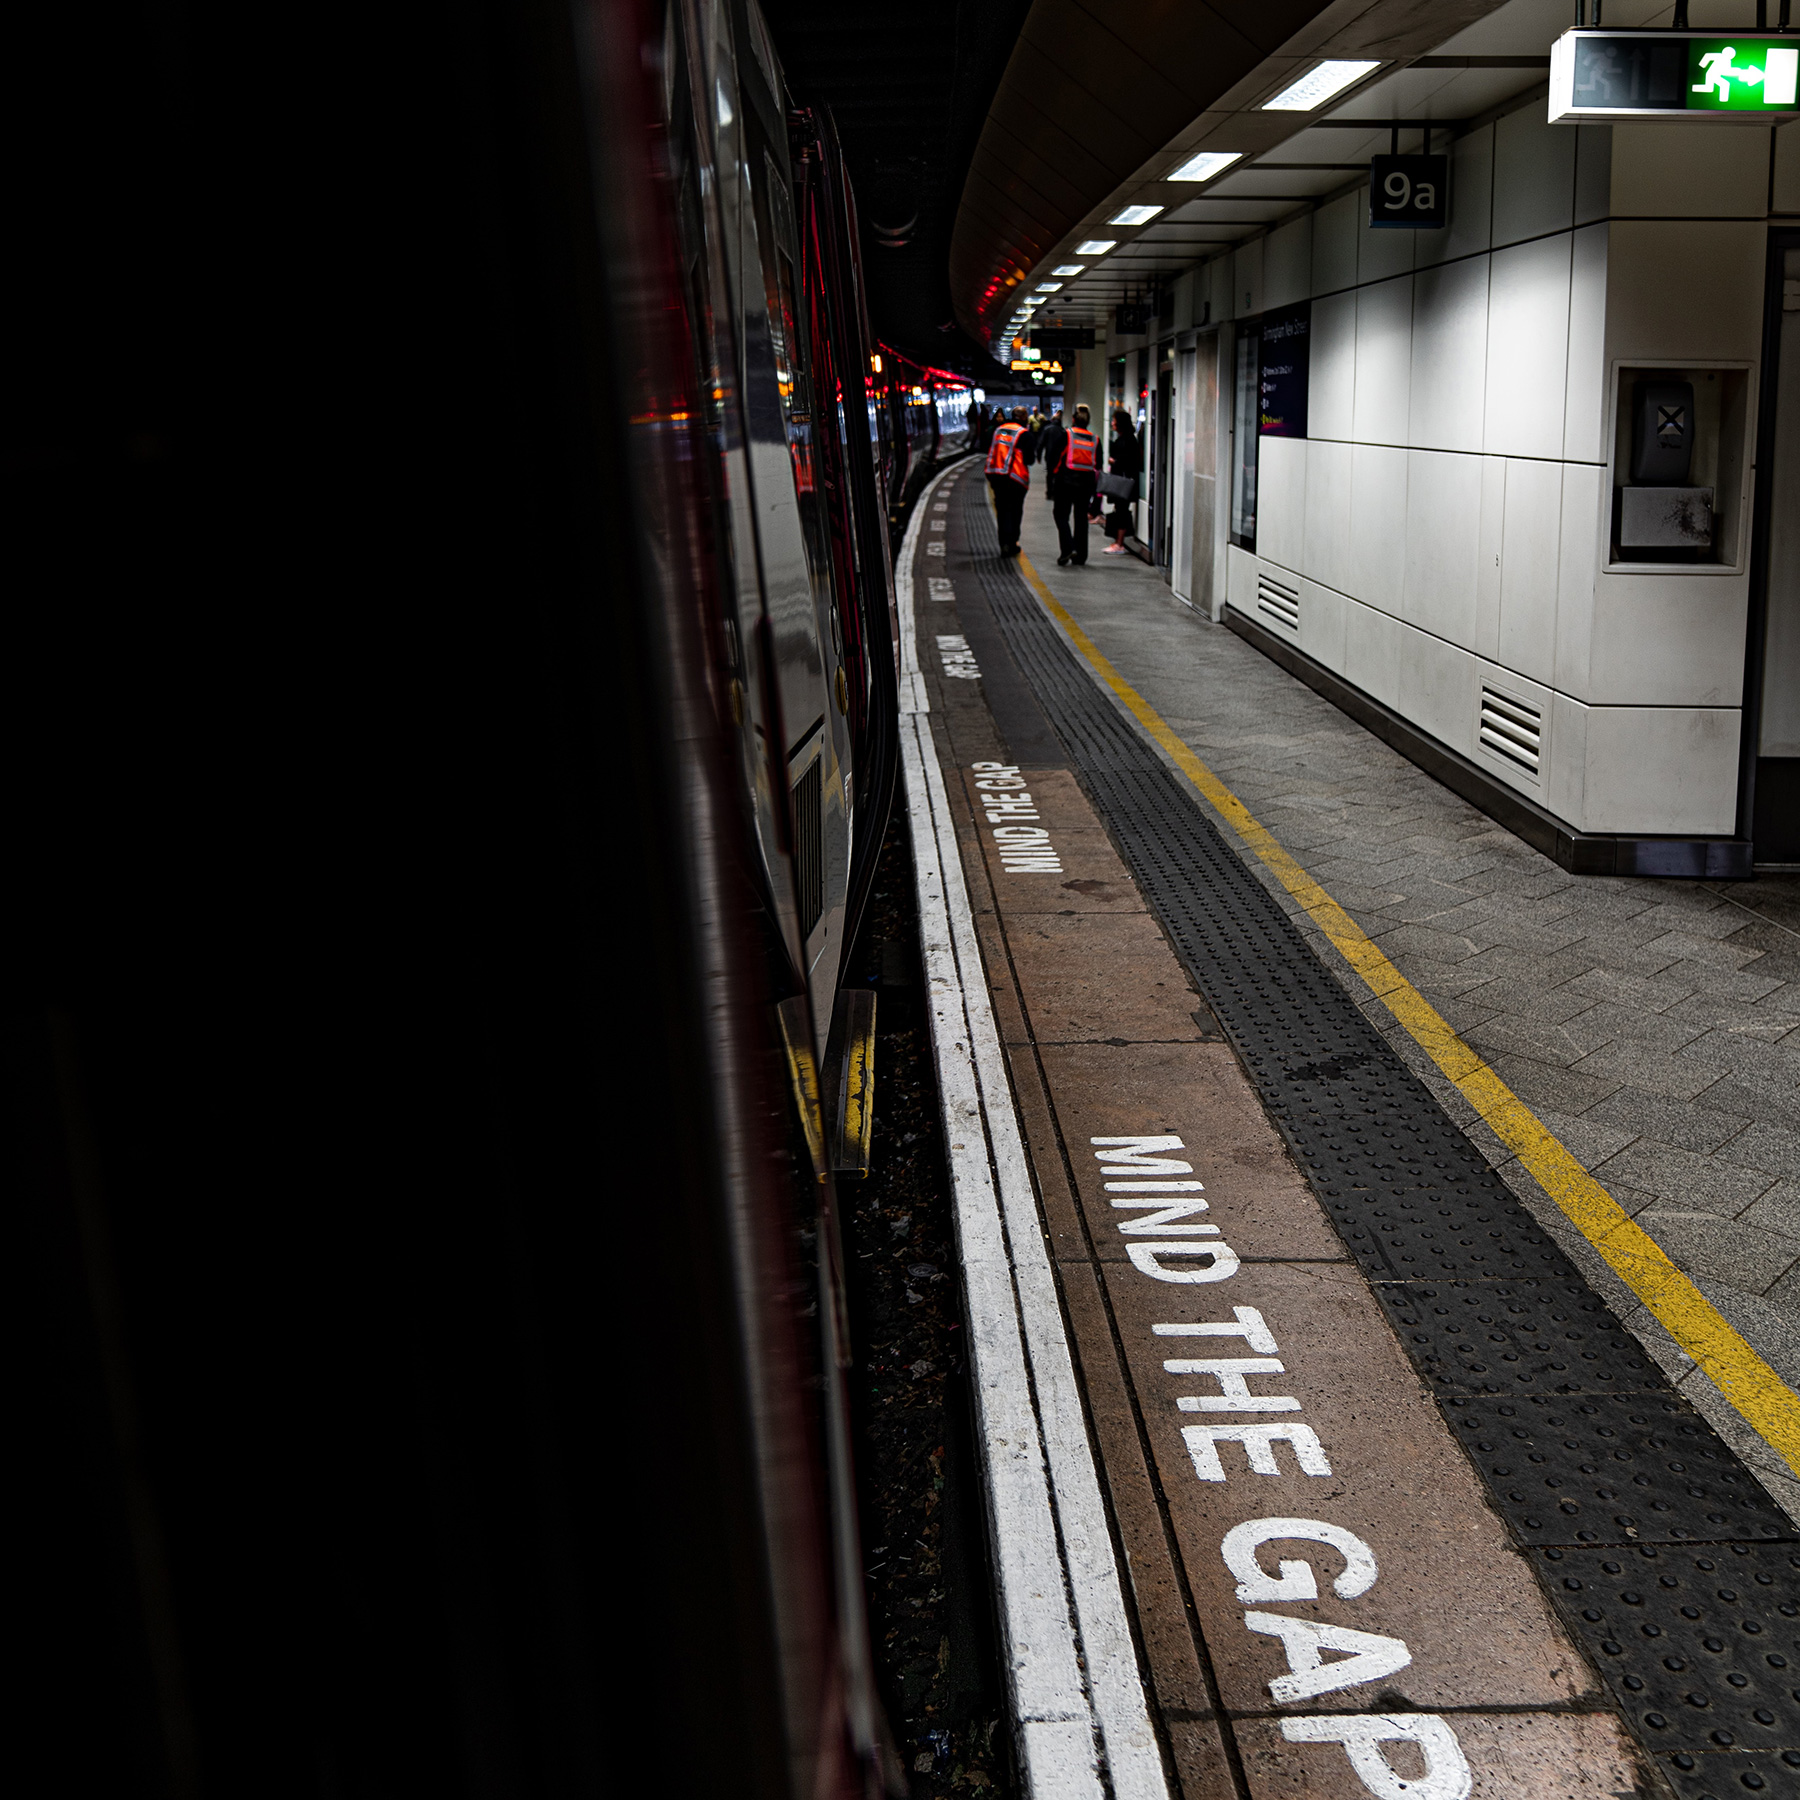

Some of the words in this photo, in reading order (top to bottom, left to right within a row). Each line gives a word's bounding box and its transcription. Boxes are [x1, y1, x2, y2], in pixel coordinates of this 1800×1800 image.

[1384, 172, 1435, 210] 9a
[970, 761, 1027, 790] GAP
[980, 793, 1040, 823] THE
[993, 826, 1064, 873] MIND
[1090, 1135, 1240, 1284] MIND
[1151, 1305, 1333, 1483] THE
[1220, 1517, 1472, 1800] GAP
